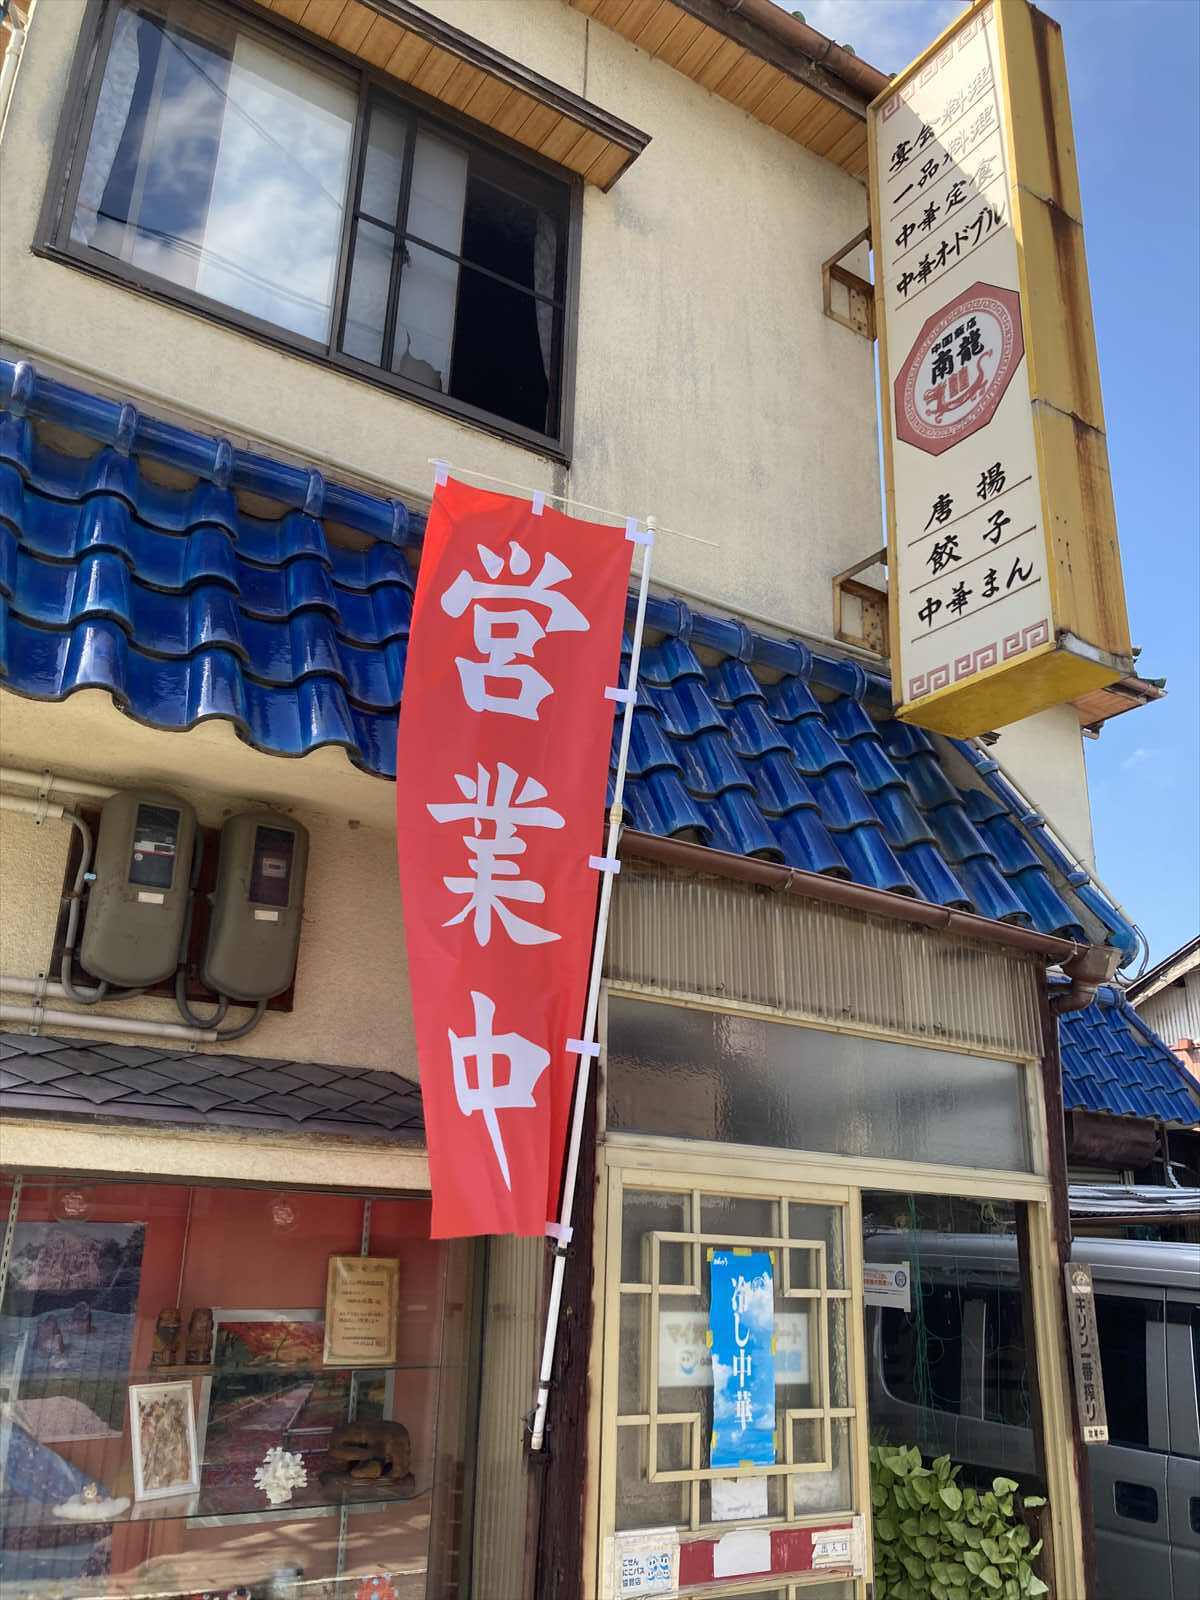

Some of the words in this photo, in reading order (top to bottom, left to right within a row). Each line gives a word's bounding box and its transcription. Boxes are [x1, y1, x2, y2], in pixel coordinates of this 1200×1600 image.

[889, 64, 992, 172] 宴会料理
[893, 104, 995, 204] 一品料理
[895, 155, 997, 249] 中華定食
[932, 328, 984, 385] 南龍
[918, 557, 1033, 627] 中華まん
[426, 541, 590, 1192] 営業中
[731, 1275, 752, 1432] 冷し中華
